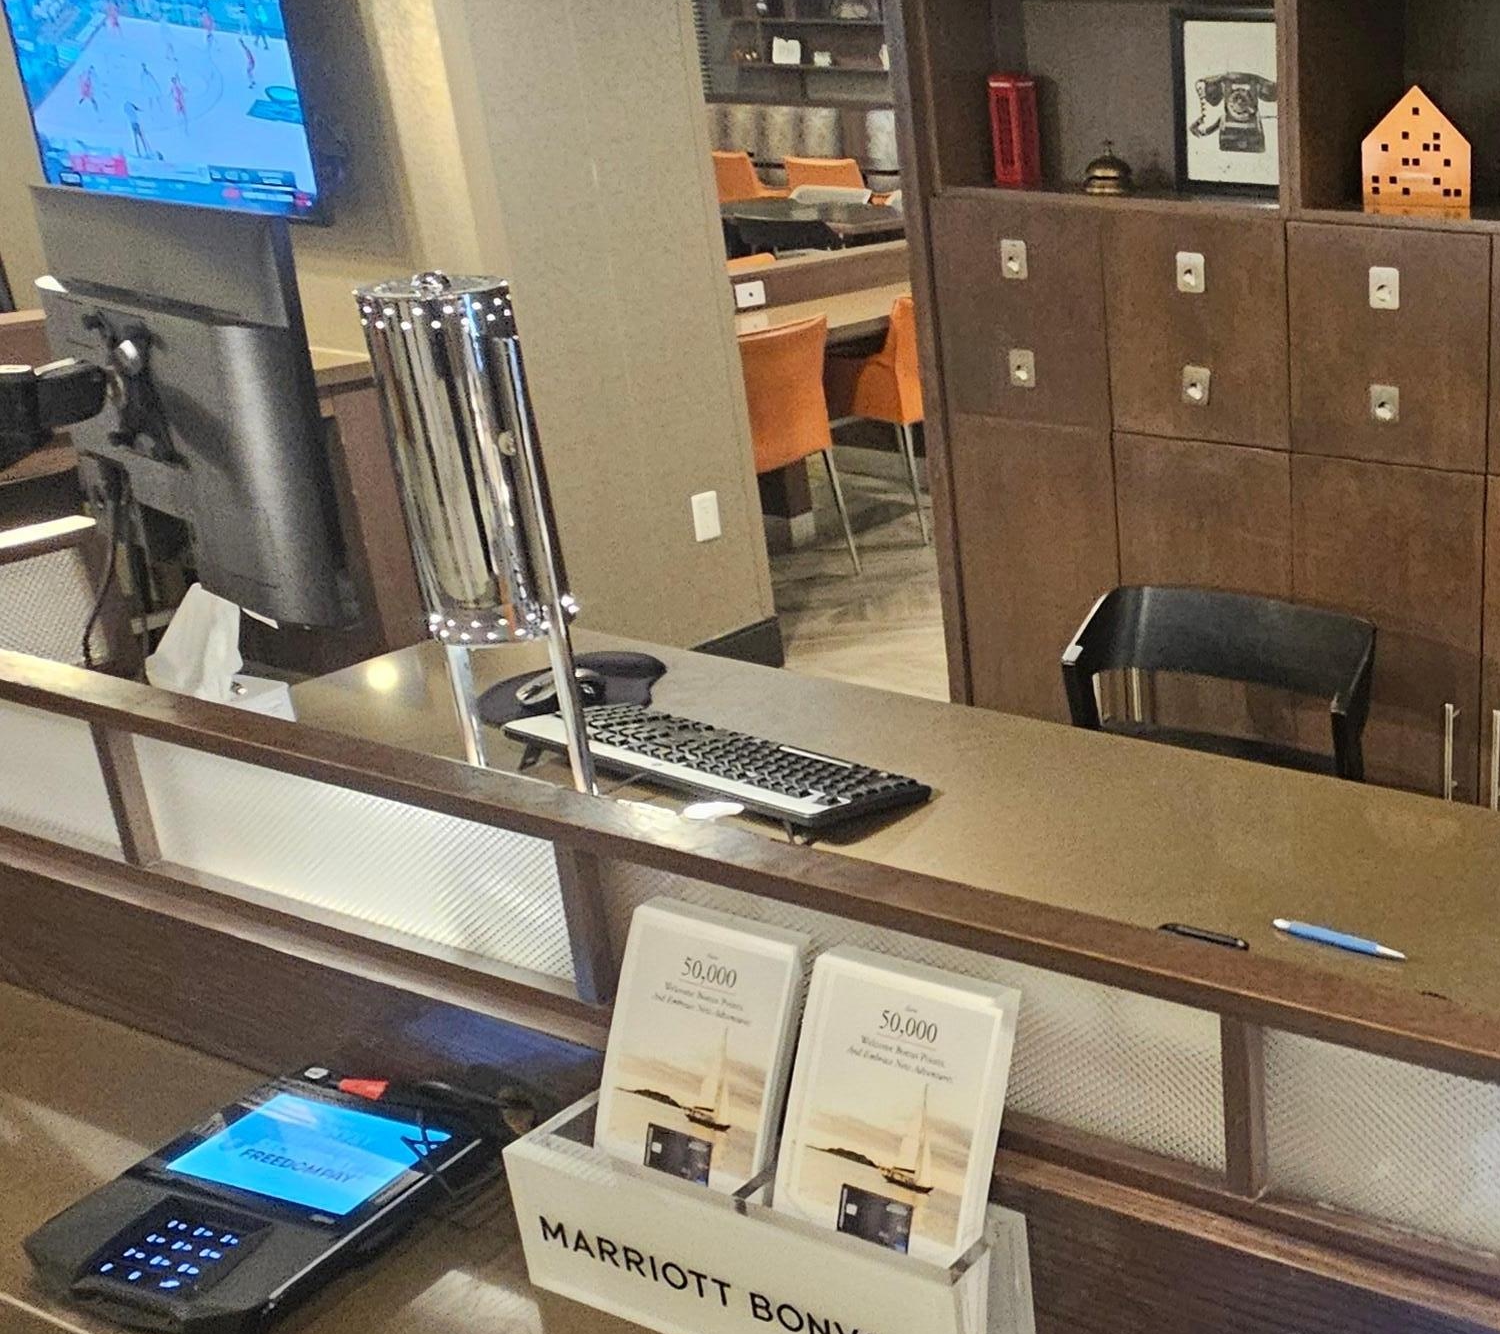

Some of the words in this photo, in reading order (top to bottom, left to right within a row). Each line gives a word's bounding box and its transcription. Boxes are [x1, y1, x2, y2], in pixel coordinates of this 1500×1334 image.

[681, 956, 737, 988] 50,000
[878, 1009, 938, 1044] 50,000
[538, 1215, 731, 1307] MARRIOTT
